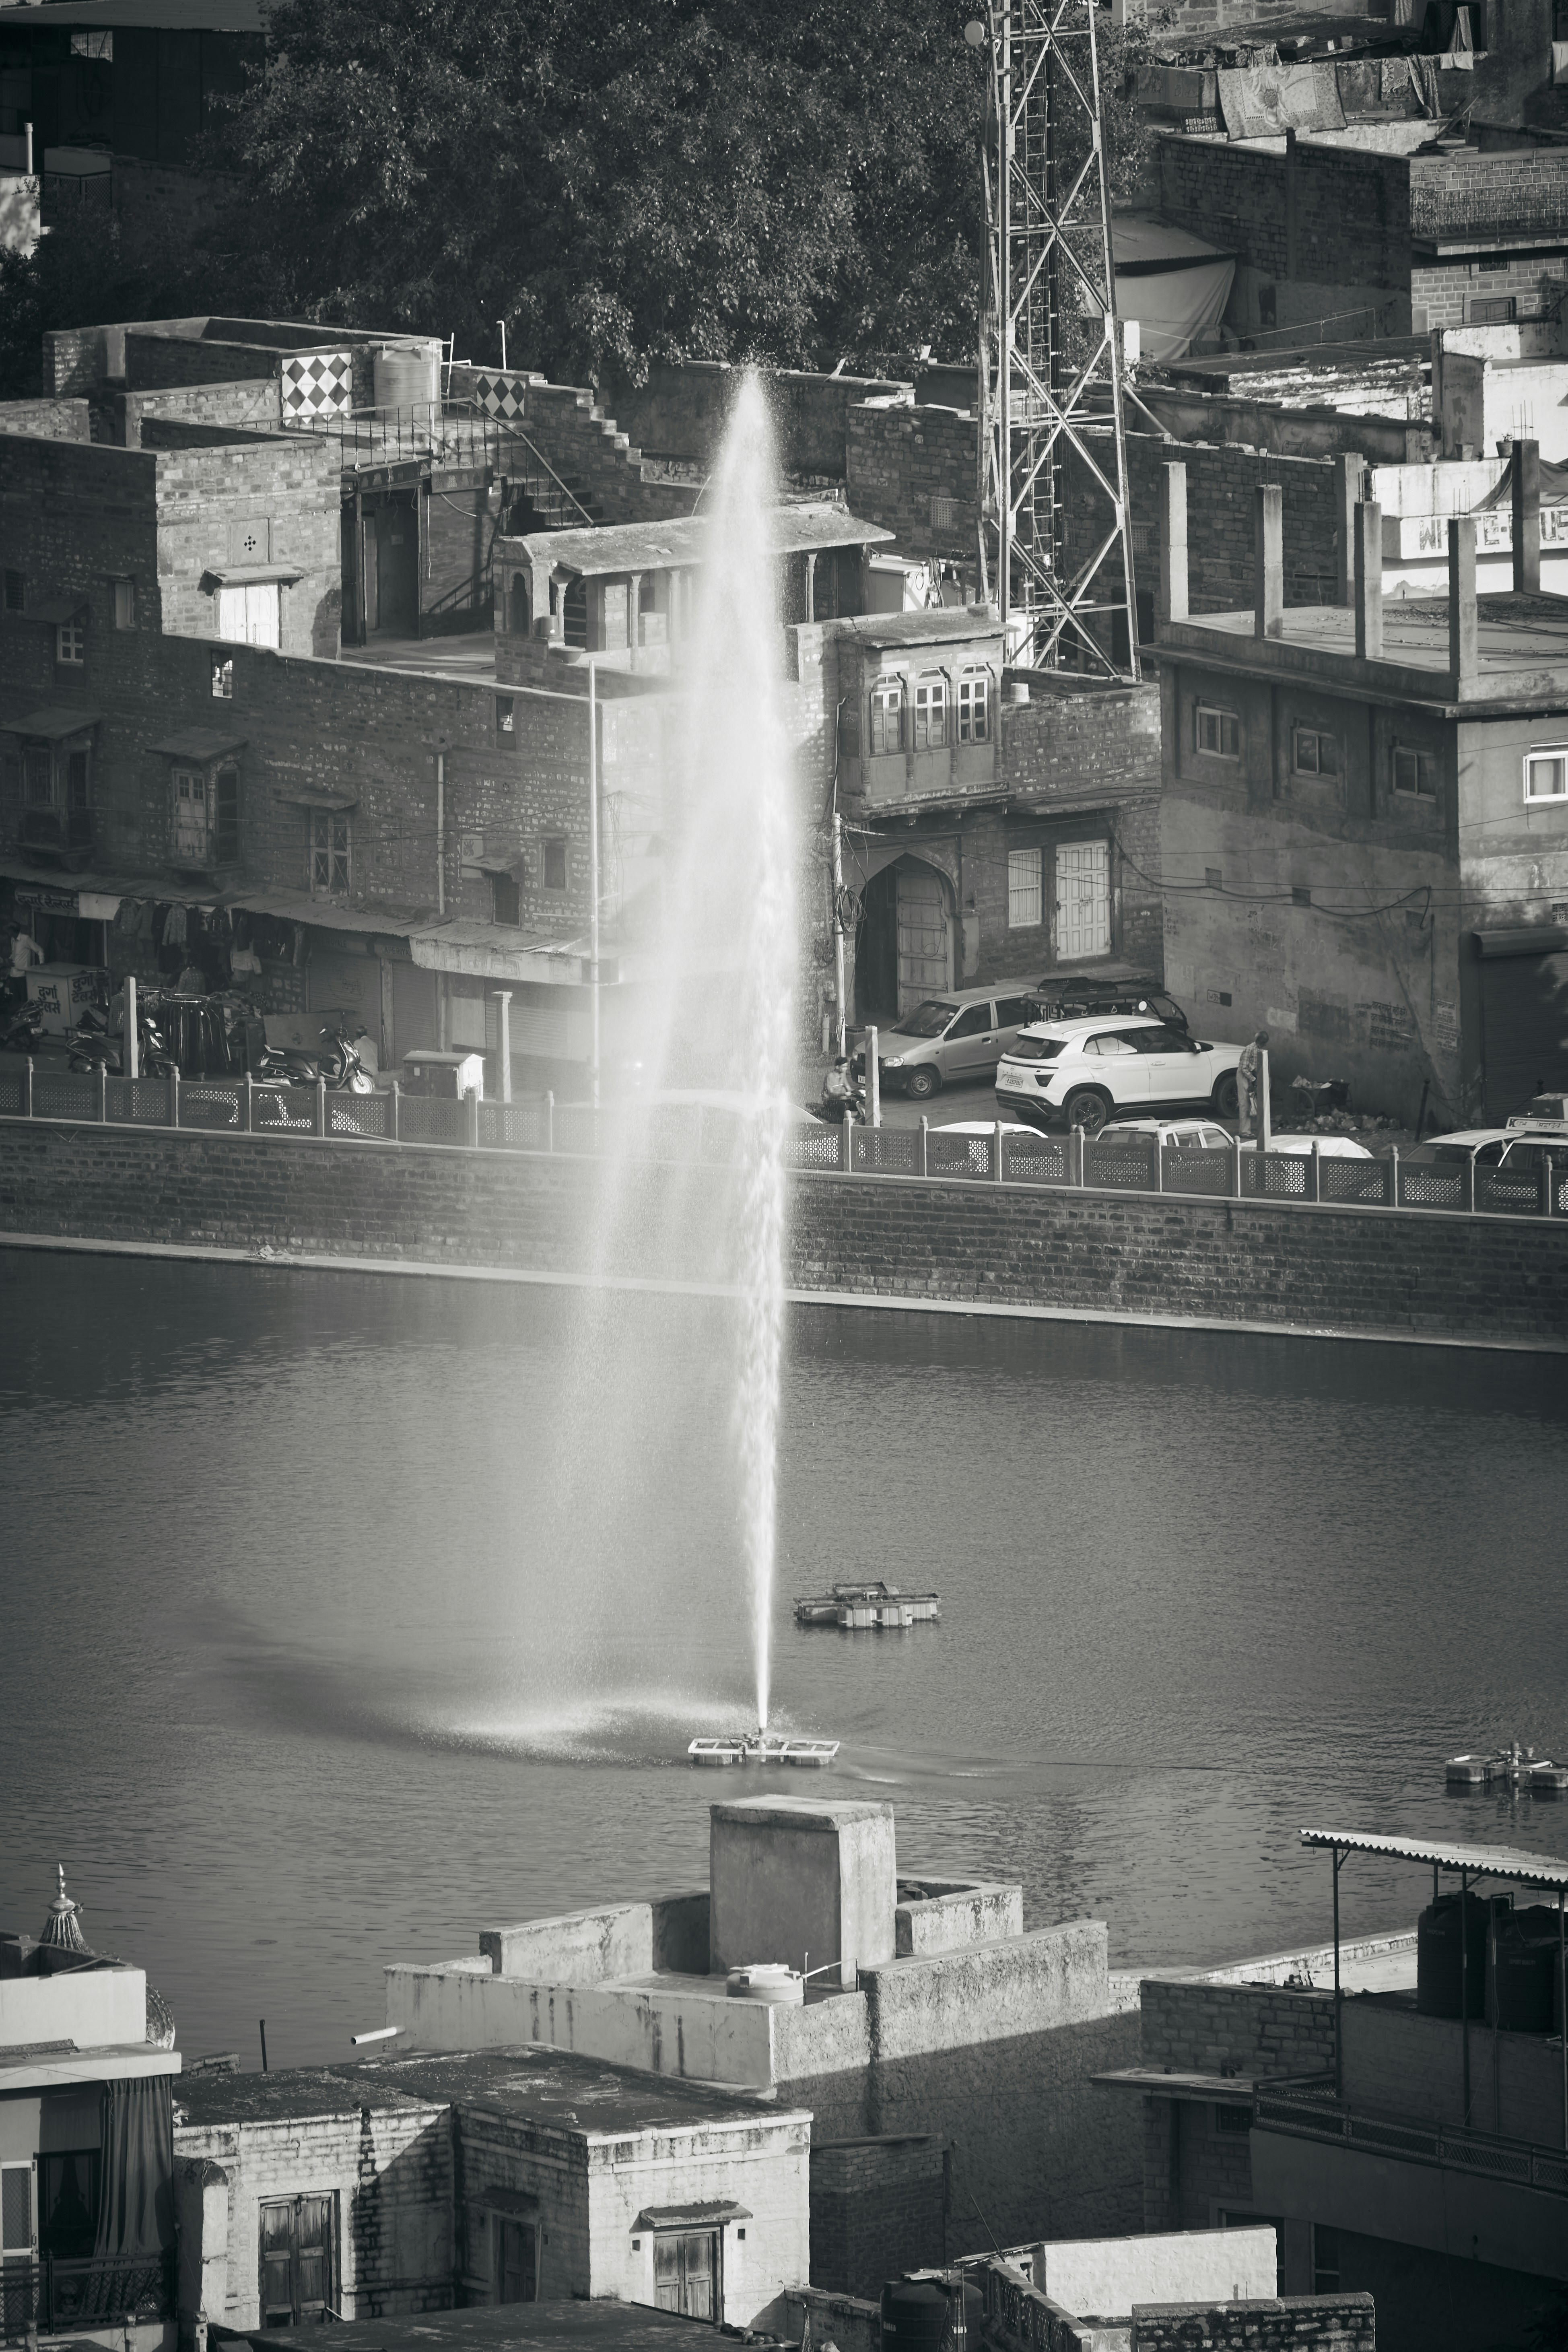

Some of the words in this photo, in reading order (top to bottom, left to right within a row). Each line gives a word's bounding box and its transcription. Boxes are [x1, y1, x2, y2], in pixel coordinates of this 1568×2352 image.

[326, 938, 347, 948] ROYALE
[72, 973, 93, 992] दुर्गा
[38, 985, 57, 1000] दुर्गा
[71, 986, 97, 1003] टेलर्स
